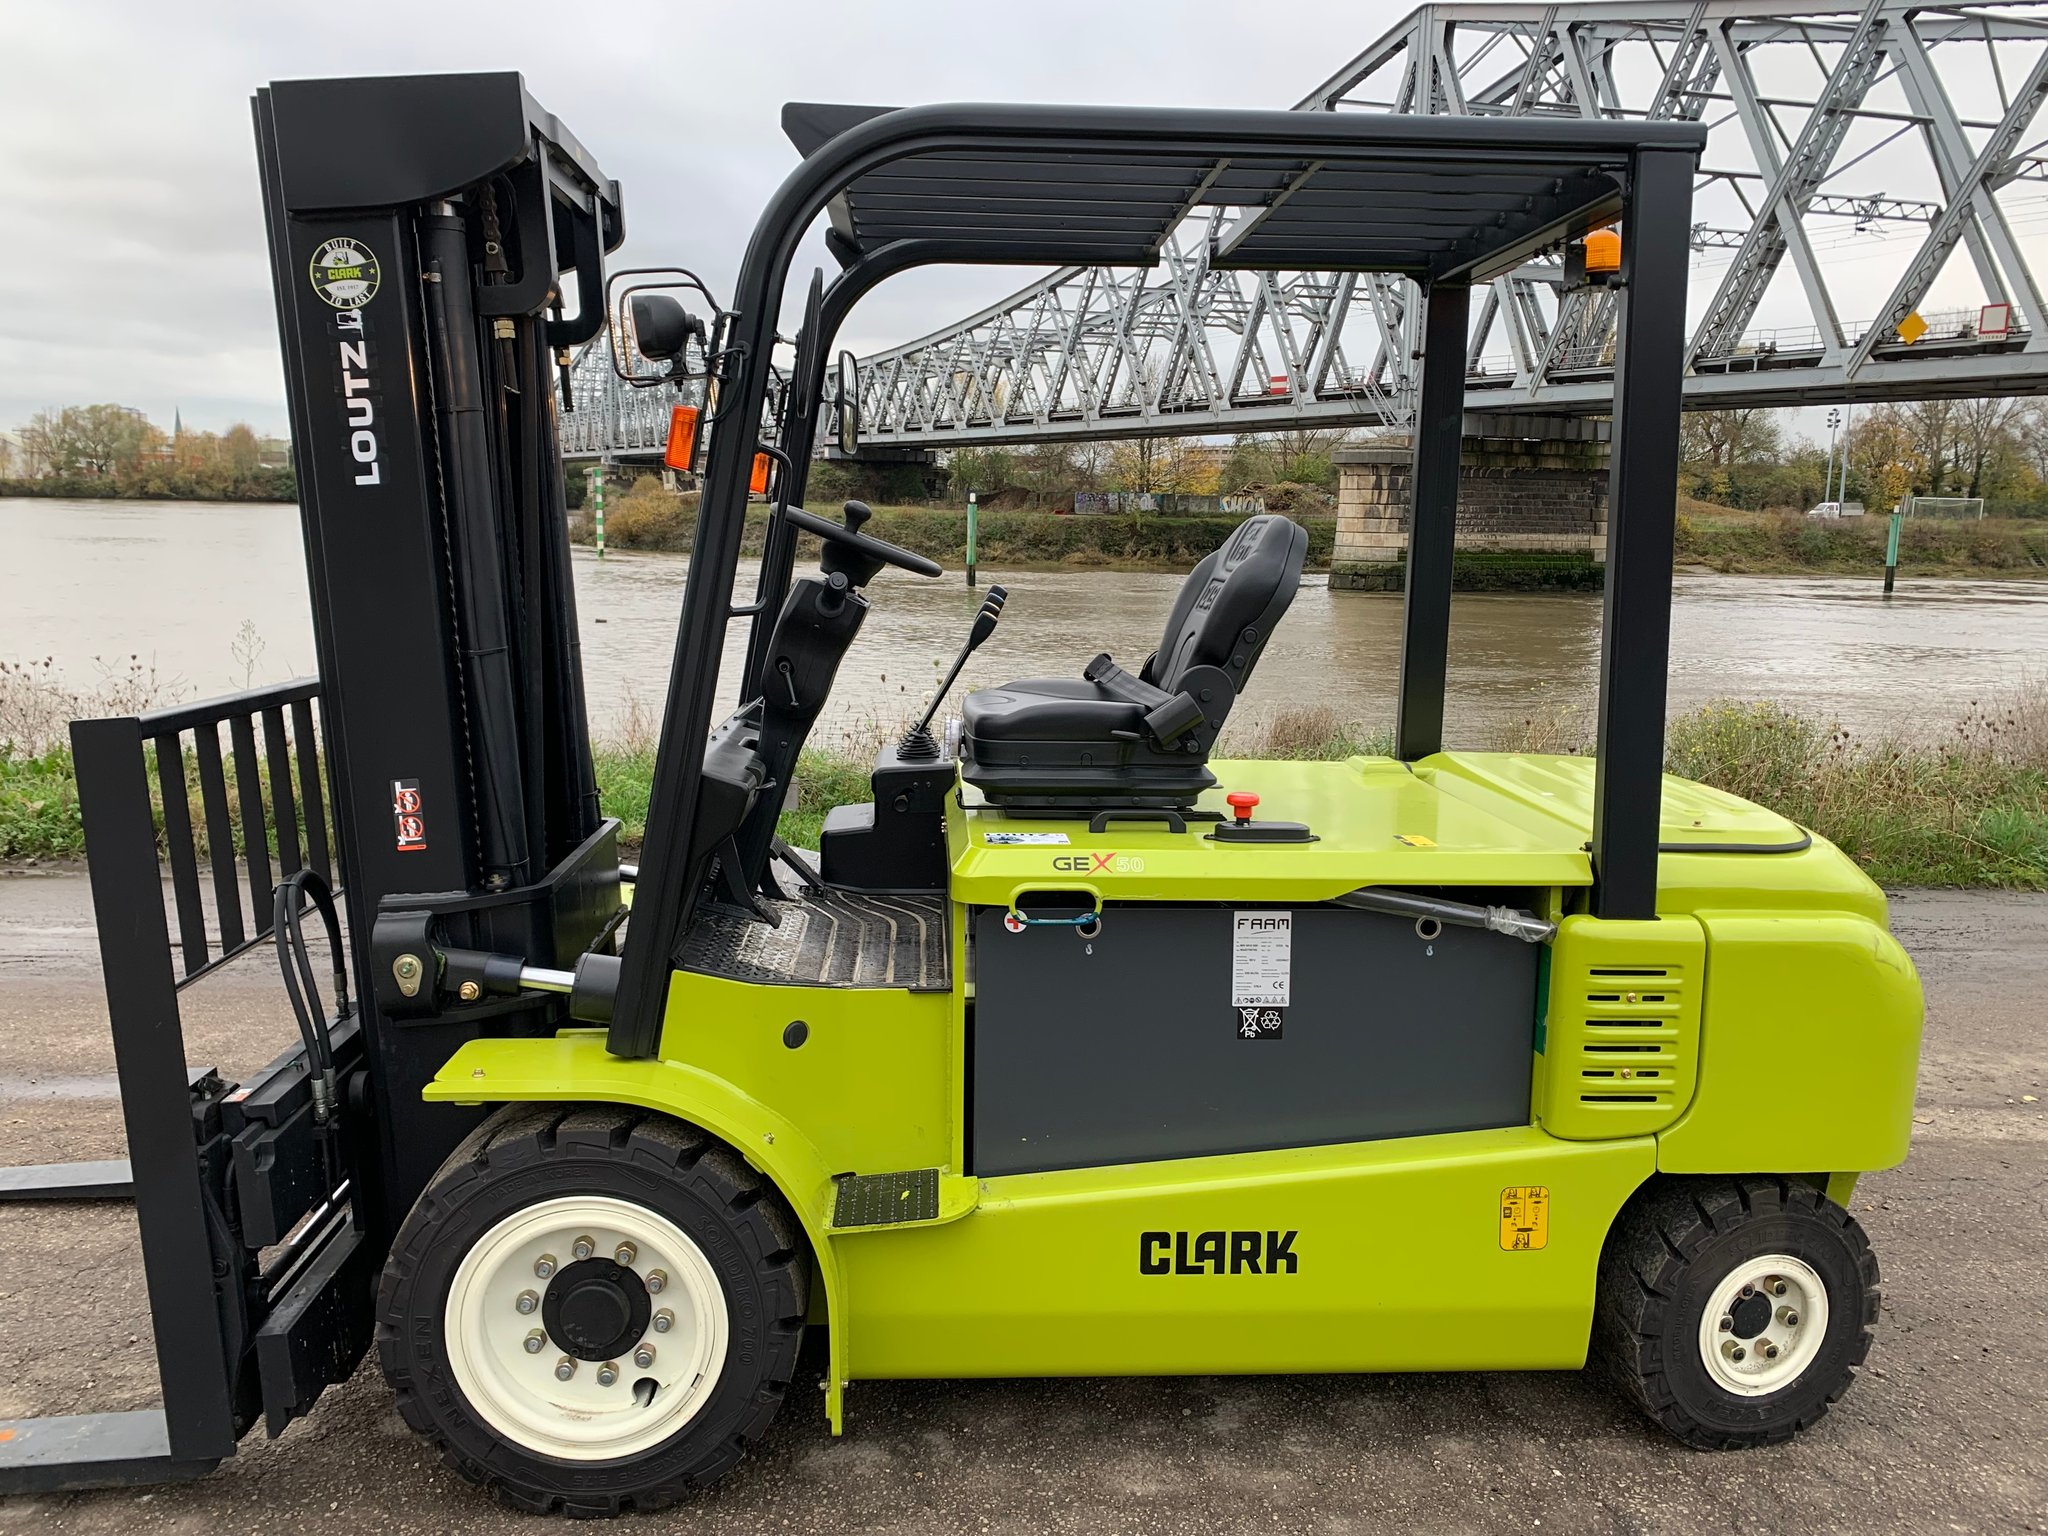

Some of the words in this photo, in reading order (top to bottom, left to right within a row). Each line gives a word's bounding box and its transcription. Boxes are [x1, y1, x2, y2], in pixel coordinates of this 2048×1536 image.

[324, 239, 356, 252] BUILT
[327, 267, 362, 280] CLARK
[330, 295, 342, 306] TO
[349, 289, 371, 307] LAST
[339, 340, 381, 486] LOUTZ
[1237, 918, 1289, 930] FAAM
[1244, 1030, 1256, 1038] Pb
[545, 1167, 592, 1180] KOREA
[1139, 1230, 1299, 1275] CLARK
[695, 1215, 757, 1320] SOLIDPRO
[739, 1325, 758, 1366] 700
[415, 1315, 470, 1432] NEXEN
